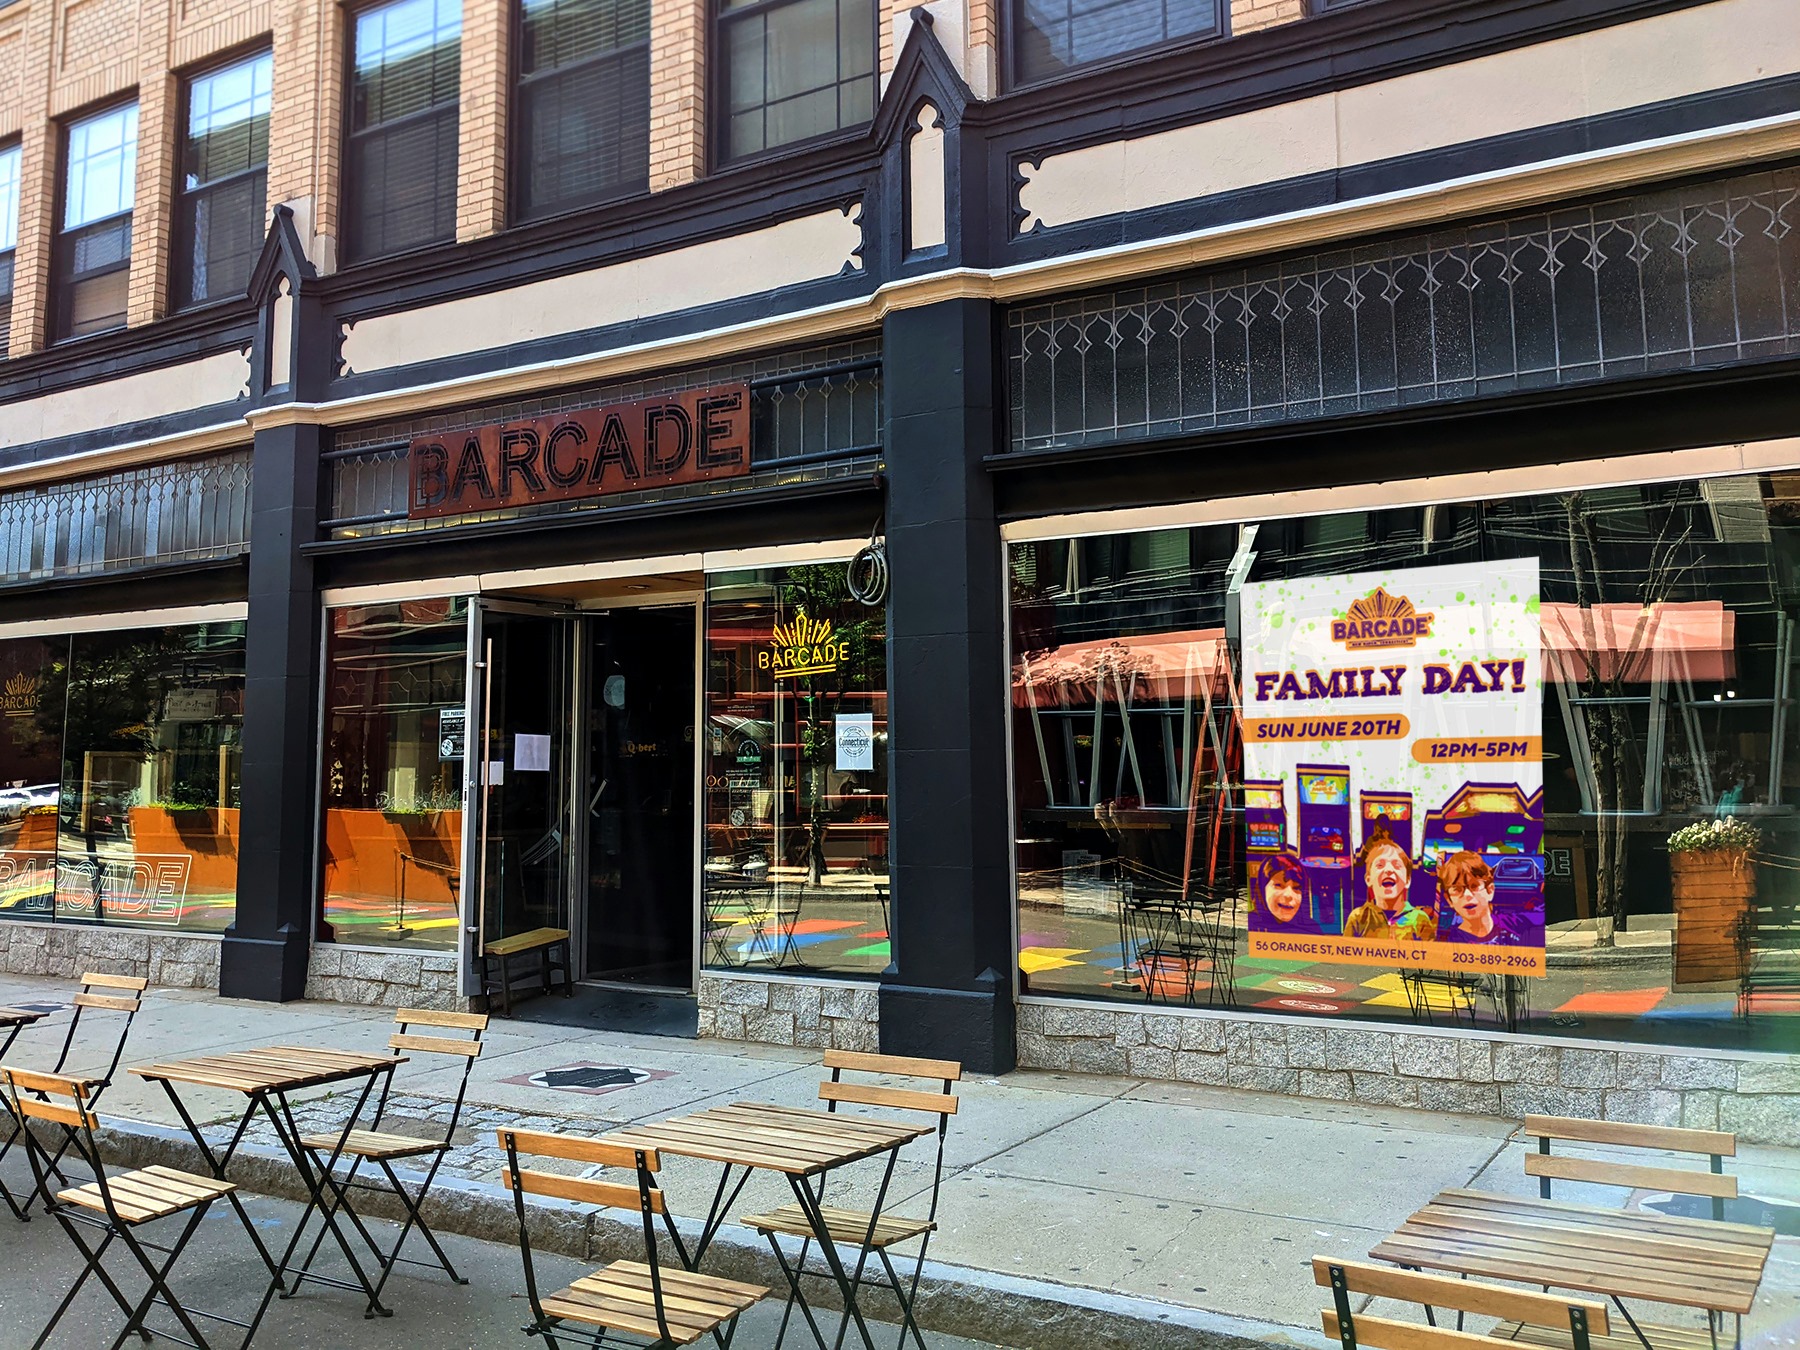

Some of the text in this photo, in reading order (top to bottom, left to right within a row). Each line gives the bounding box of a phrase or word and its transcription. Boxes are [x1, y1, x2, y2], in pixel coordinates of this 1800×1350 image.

[411, 391, 744, 510] BARCADE
[1333, 616, 1427, 640] BARCADE
[758, 641, 850, 670] BARCADE
[1254, 658, 1526, 701] FAMILY DAY!
[1257, 719, 1401, 739] SUN JUNE 20TH
[1430, 741, 1528, 759] 12PM-5PM
[0, 856, 185, 917] BARCADE
[1255, 940, 1427, 961] 56 ORANGE ST, NEW HAVEN, CT
[1452, 952, 1537, 968] 203-889-2966
